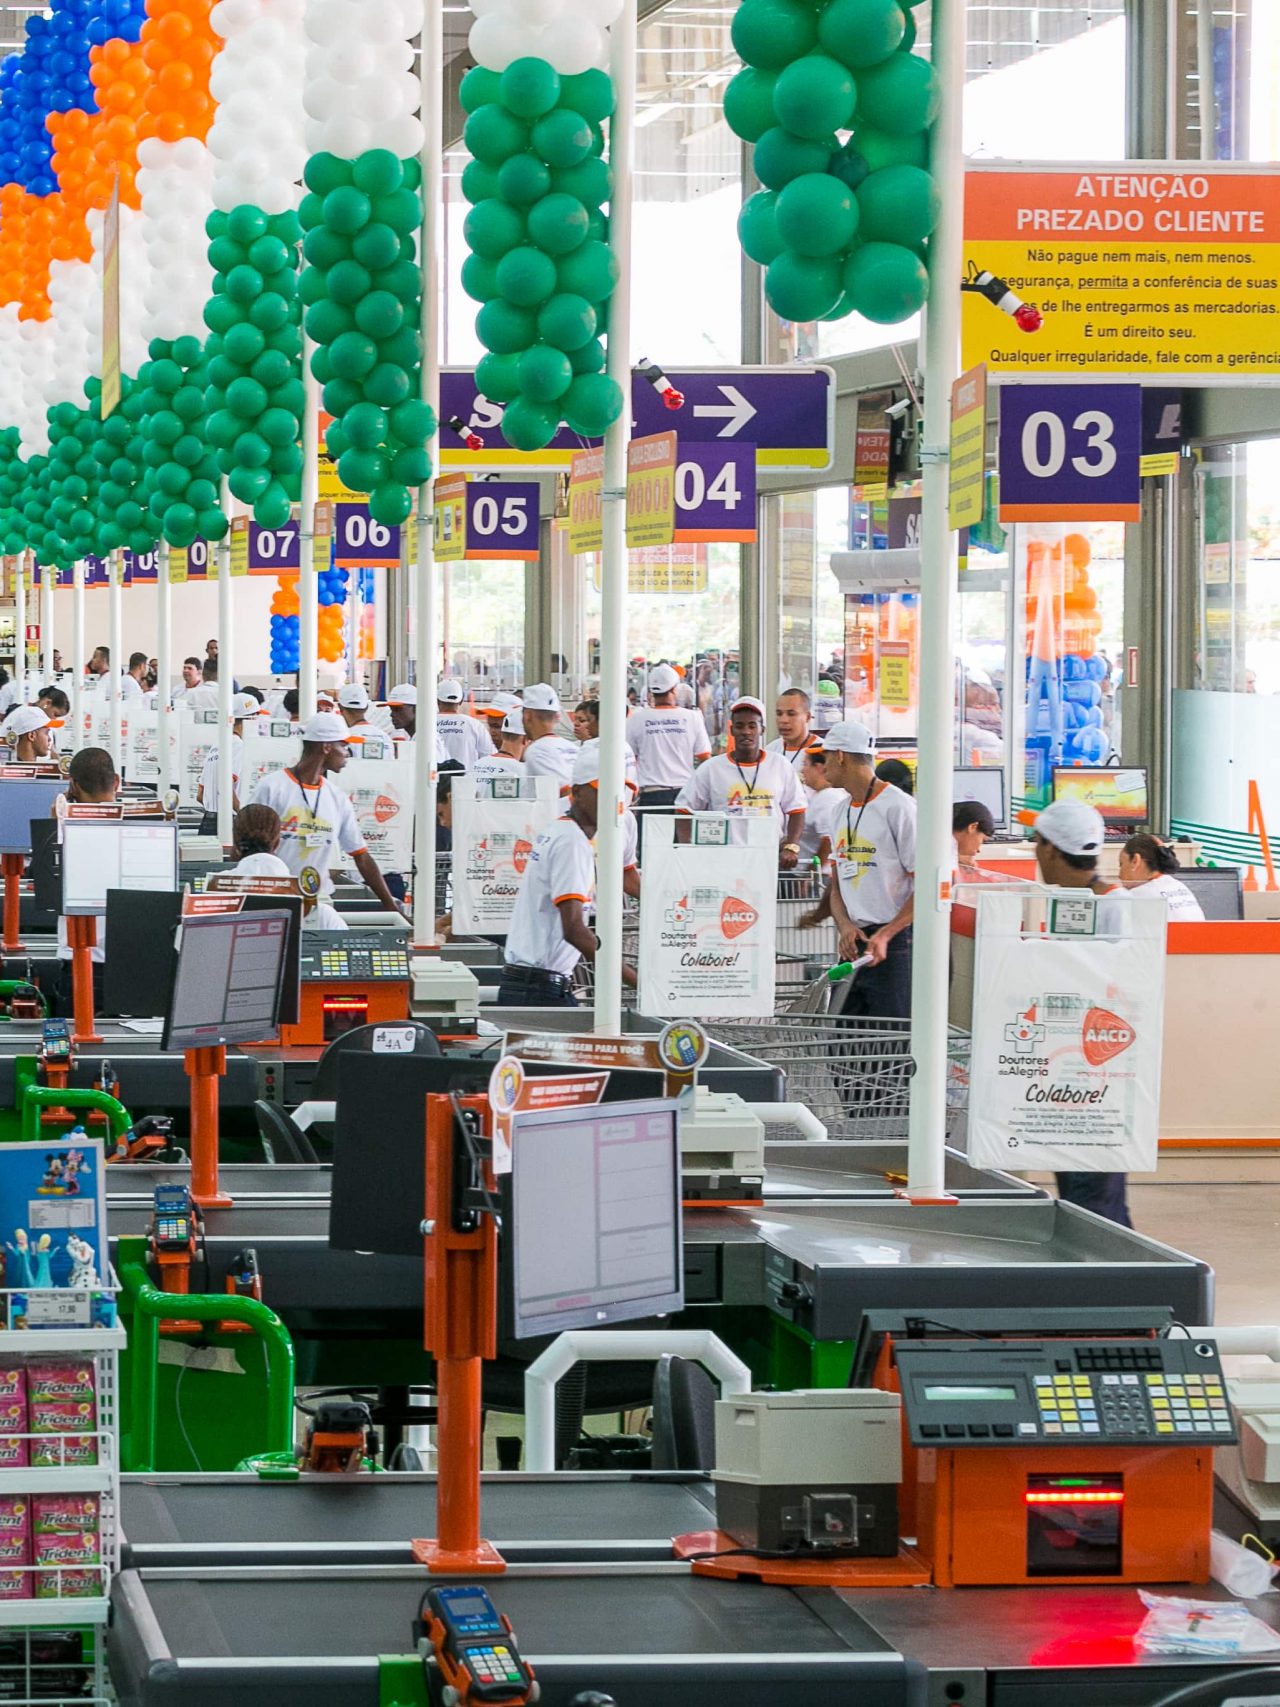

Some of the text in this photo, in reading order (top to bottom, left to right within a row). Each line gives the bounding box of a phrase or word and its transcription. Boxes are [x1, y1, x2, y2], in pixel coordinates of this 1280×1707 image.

[1075, 174, 1209, 203] ATENÇÃO
[1017, 208, 1265, 232] PREZADO CLIENTE
[1027, 249, 1255, 265] Não pague nem mais, nem menos.
[1001, 274, 1278, 290] segurança, permita a conferência de suas
[1041, 300, 1058, 312] de
[1061, 300, 1081, 312] lhe
[1086, 301, 1170, 316] entregarmos
[1174, 303, 1189, 314] as
[1193, 301, 1280, 314] mercadorias.
[1084, 321, 1196, 339] É um direito seu.
[990, 349, 1051, 364] Qualquer
[1055, 350, 1152, 365] irregularidade,
[1156, 351, 1179, 364] fale
[1183, 353, 1212, 364] com
[1216, 353, 1224, 364] a
[1021, 410, 1118, 478] 03
[674, 461, 742, 511] 04
[472, 497, 528, 536] 05
[345, 515, 391, 548] 06
[256, 530, 296, 558] 07
[722, 911, 754, 923] AACD
[681, 951, 739, 968] Colabore!
[1085, 1029, 1131, 1043] AACD
[998, 1055, 1049, 1066] Doutores
[1025, 1083, 1108, 1104] Colabore!
[35, 1381, 86, 1394] Trident
[37, 1413, 88, 1426] Trident
